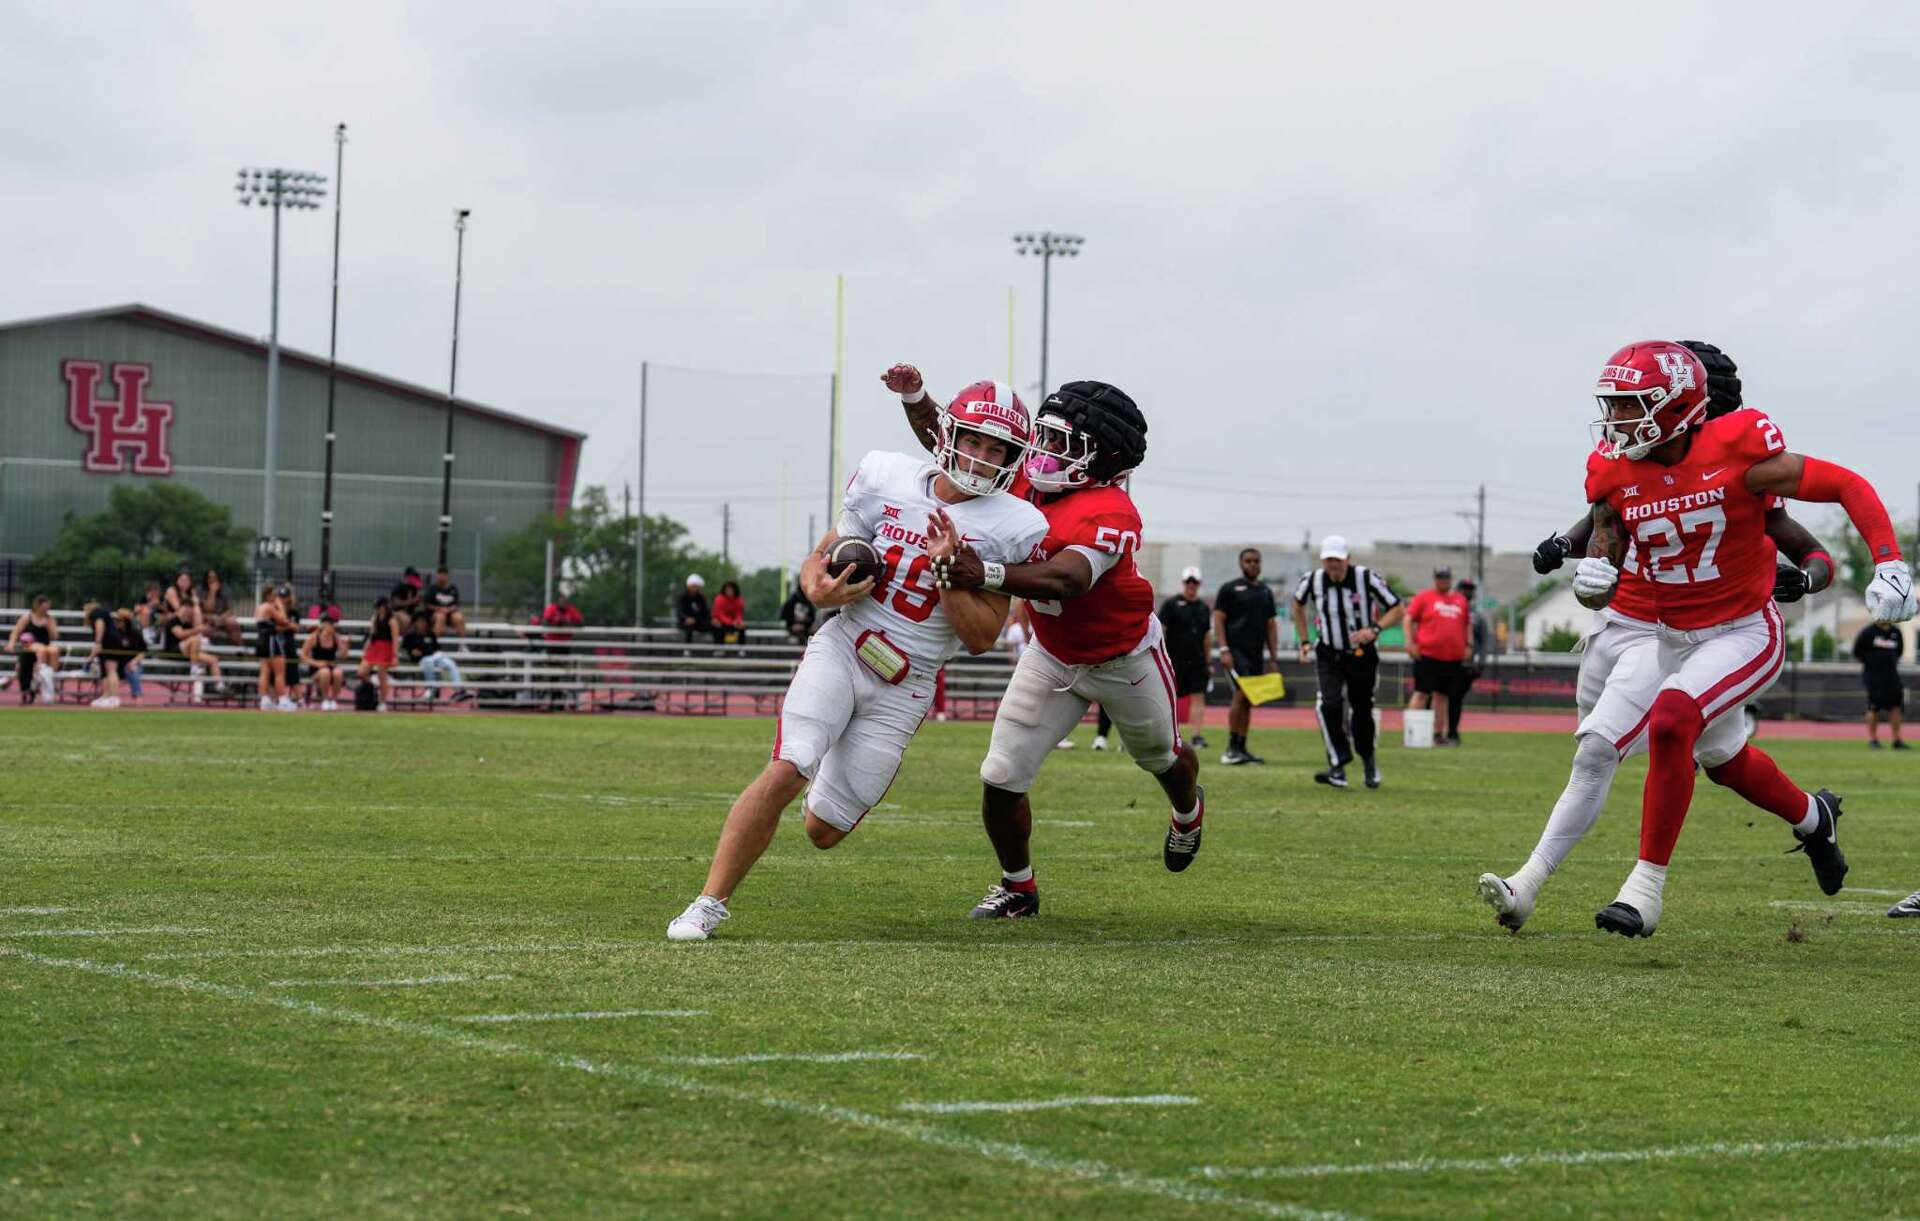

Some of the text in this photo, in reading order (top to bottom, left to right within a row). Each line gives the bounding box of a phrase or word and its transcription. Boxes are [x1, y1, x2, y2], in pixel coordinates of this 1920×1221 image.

[973, 402, 1026, 430] CARLISLE
[1756, 418, 1784, 451] 2
[1624, 486, 1726, 520] HOUSTON
[880, 521, 930, 551] HOUS
[1094, 526, 1139, 554] 50
[1636, 504, 1728, 584] 27
